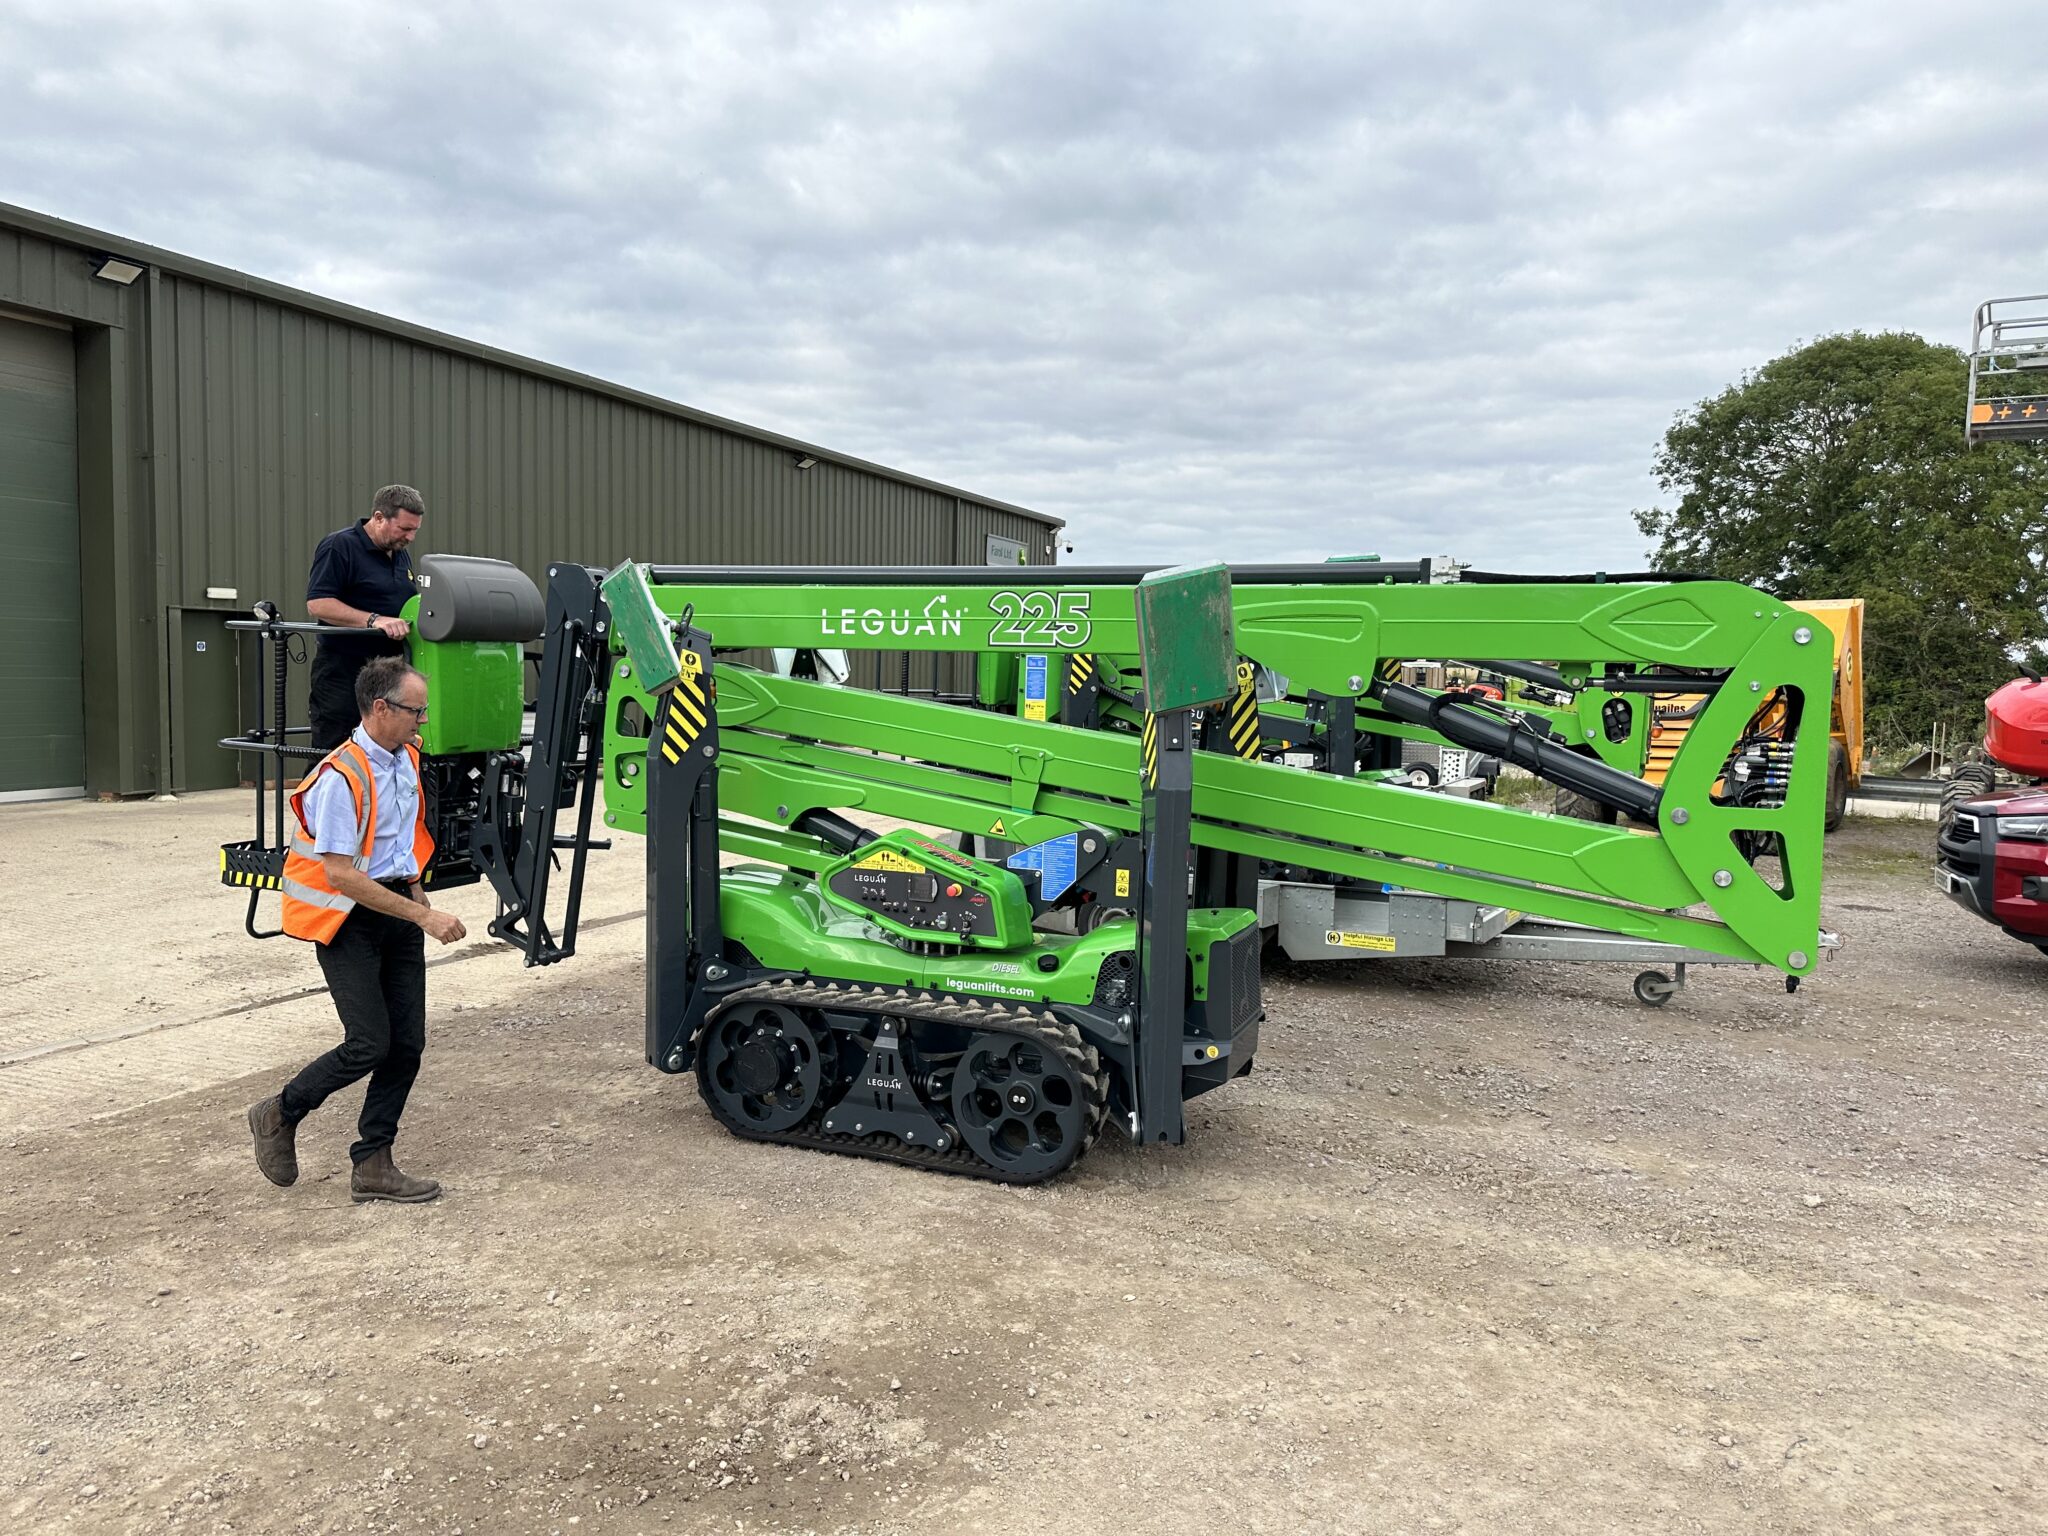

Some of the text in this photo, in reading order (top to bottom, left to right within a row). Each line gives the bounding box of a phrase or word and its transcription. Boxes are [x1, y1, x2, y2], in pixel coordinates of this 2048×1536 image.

[821, 590, 1093, 649] LEGUAN 225
[854, 873, 887, 884] LEGUAN
[991, 962, 1020, 975] DIESEL
[946, 977, 1035, 997] leguanlifts.com
[867, 1077, 902, 1090] LEGUAN
